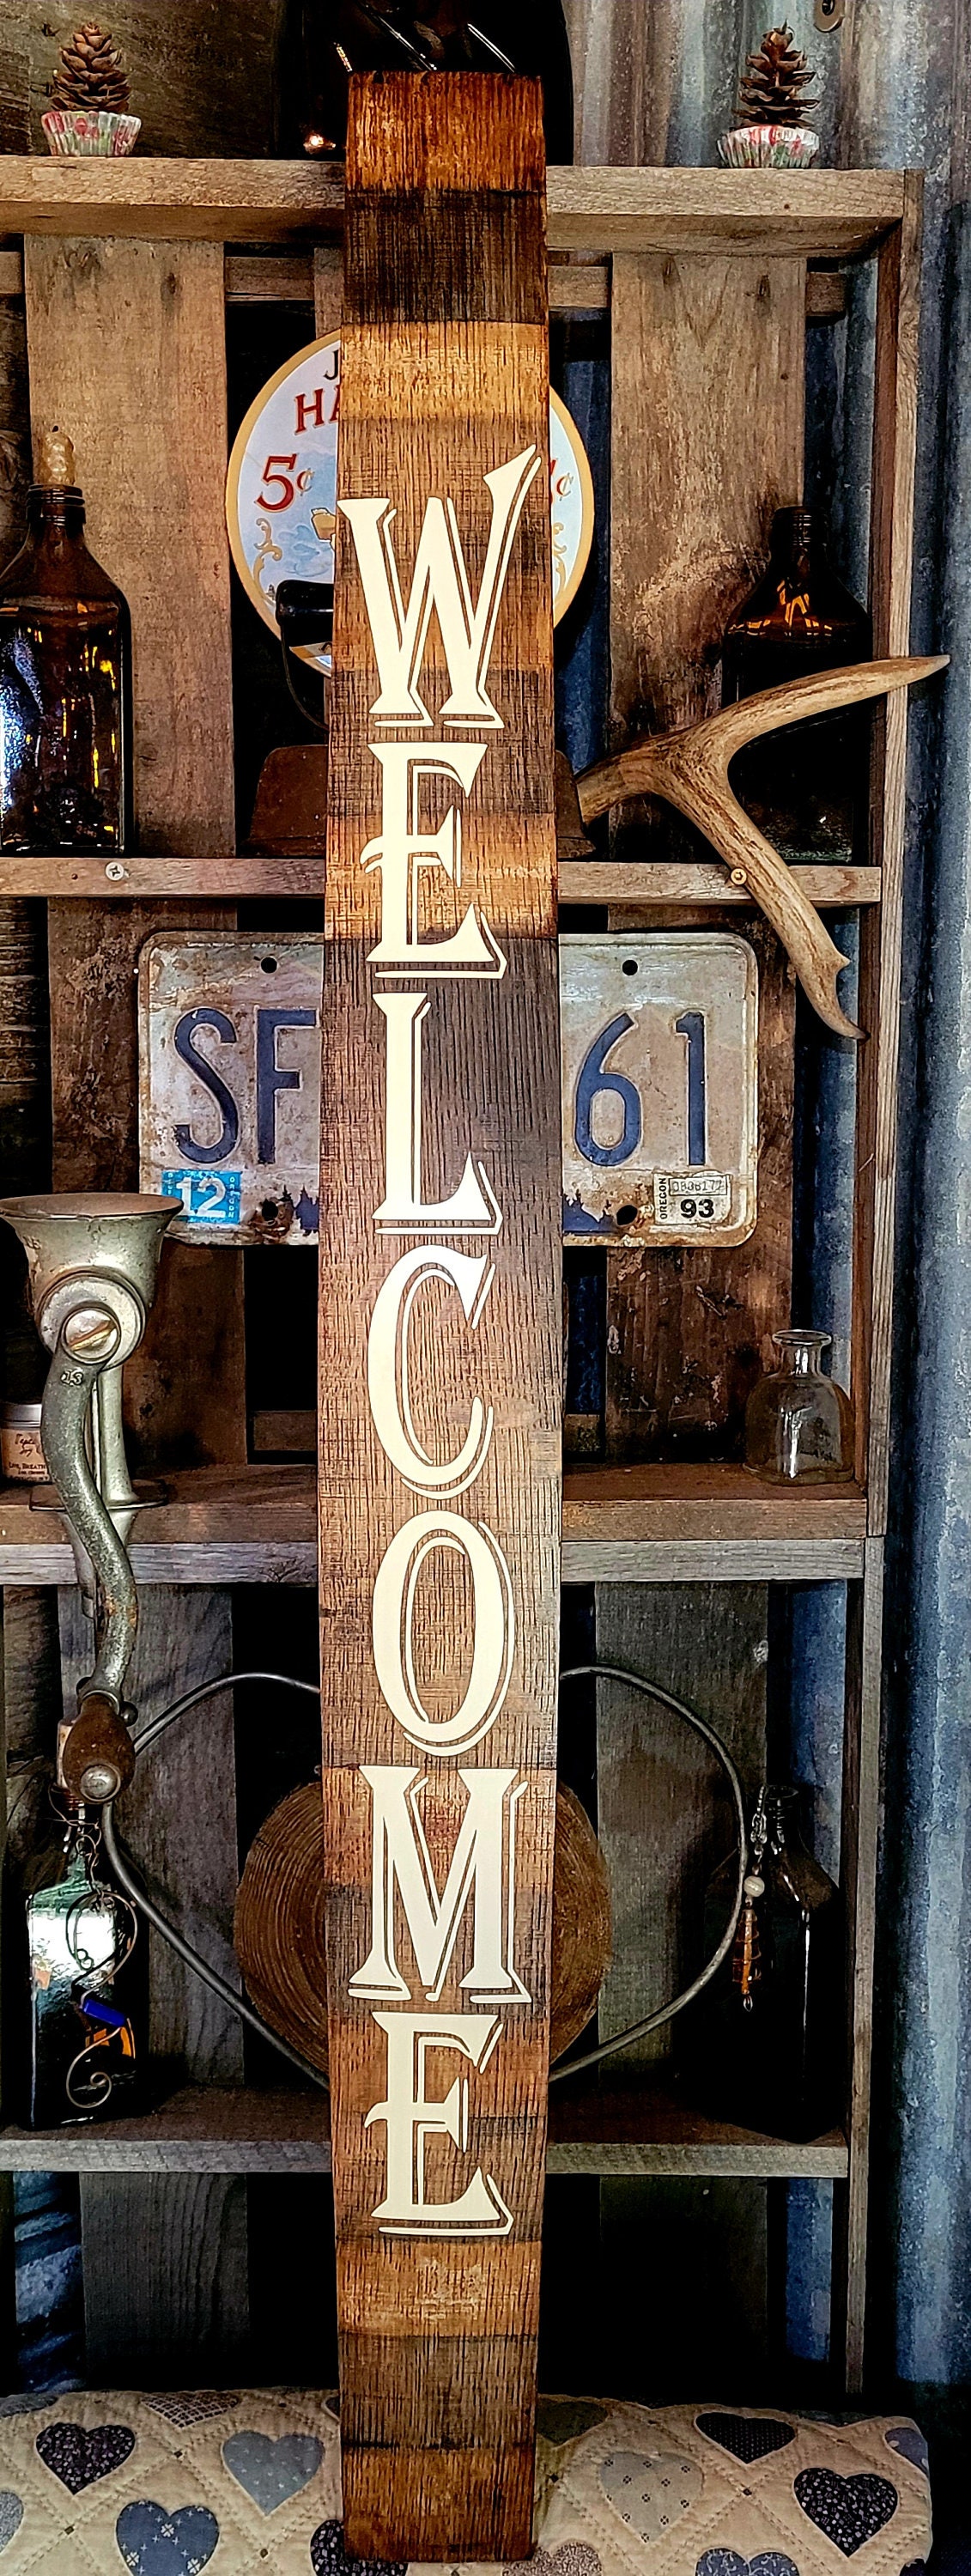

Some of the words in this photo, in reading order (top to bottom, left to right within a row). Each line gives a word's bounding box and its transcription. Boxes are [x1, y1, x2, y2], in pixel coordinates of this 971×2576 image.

[254, 453, 314, 513] 5¢
[173, 1007, 318, 1165] SF
[574, 1012, 707, 1167] 61
[175, 1176, 227, 1218] 12
[658, 1177, 668, 1220] OREGON
[680, 1198, 715, 1218] 93
[336, 443, 542, 2237] WELCOME
